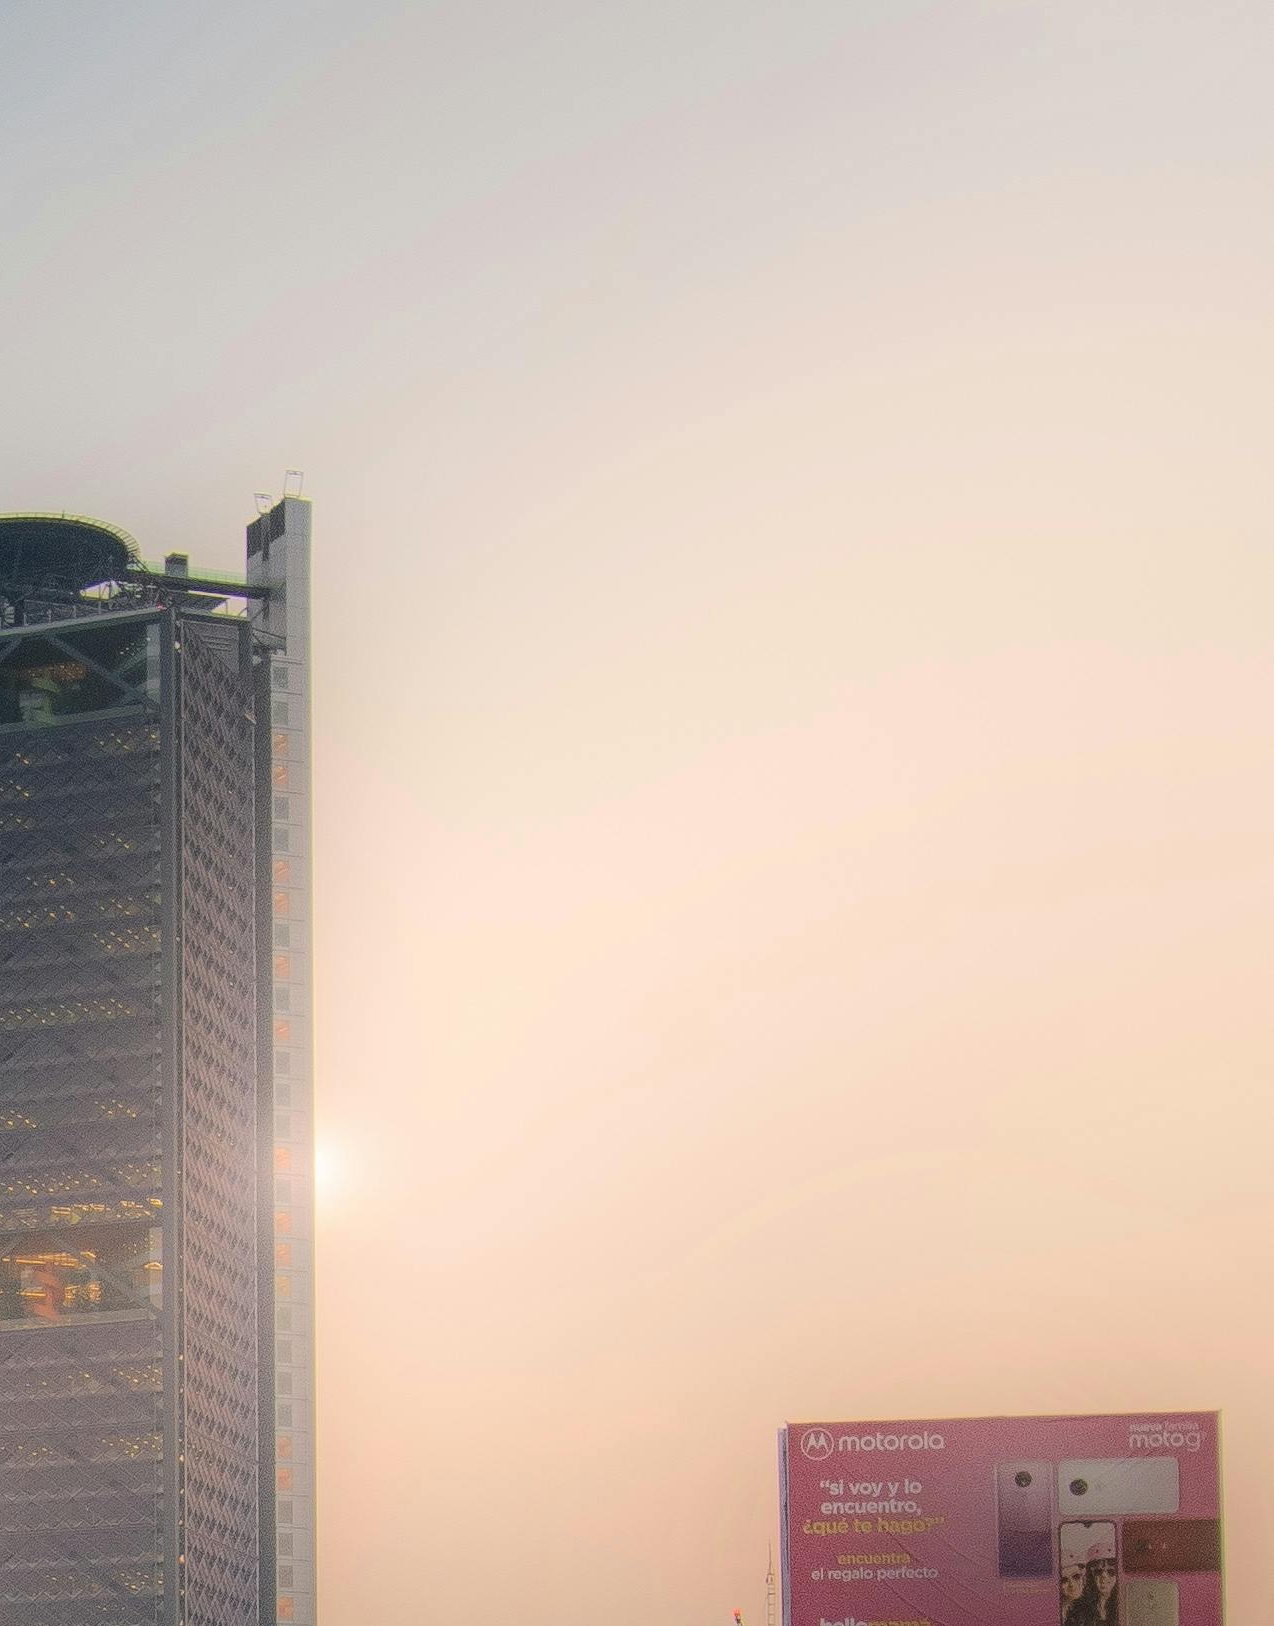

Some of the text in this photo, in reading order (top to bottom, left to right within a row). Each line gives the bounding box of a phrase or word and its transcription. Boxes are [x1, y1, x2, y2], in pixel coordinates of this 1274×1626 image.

[839, 1431, 946, 1451] motorola
[850, 1481, 882, 1497] voy
[888, 1482, 899, 1496] y
[906, 1479, 922, 1494] lo
[821, 1499, 921, 1515] encuentro,
[811, 1568, 939, 1581] el regalo perfecto
